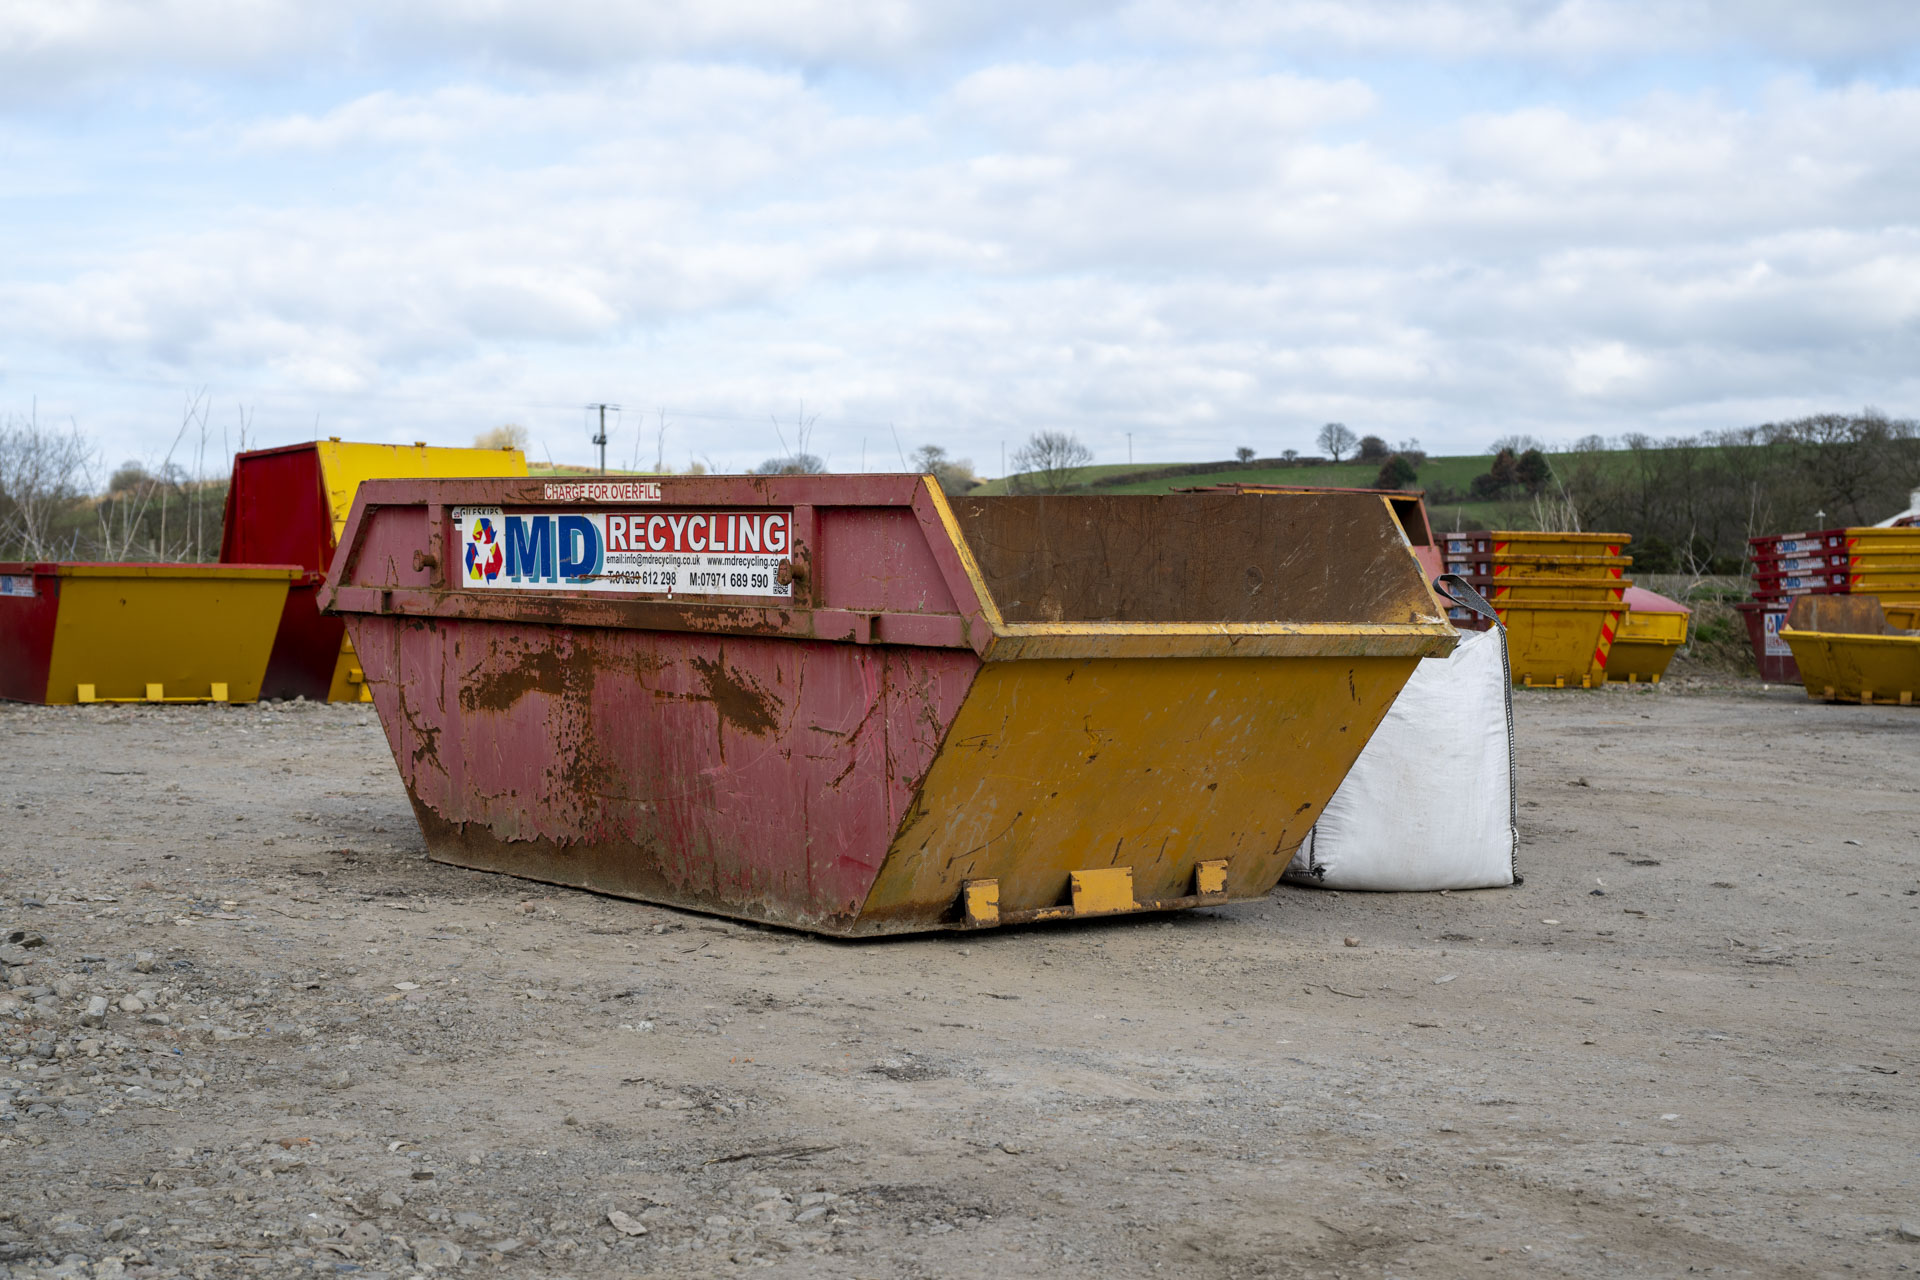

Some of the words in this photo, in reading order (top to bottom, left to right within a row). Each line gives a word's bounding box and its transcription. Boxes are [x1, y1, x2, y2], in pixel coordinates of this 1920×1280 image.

[545, 485, 585, 499] CHARGE
[588, 485, 608, 499] FOR
[611, 484, 660, 499] OVERFILL
[609, 514, 787, 553] RECYCLING
[505, 515, 602, 582] MD
[606, 554, 700, 567] email:info@mdrecycling.co.uk
[642, 571, 658, 585] 612
[661, 571, 676, 585] 298
[689, 571, 726, 587] M:07971
[730, 573, 748, 588] 689
[751, 574, 768, 588] 590
